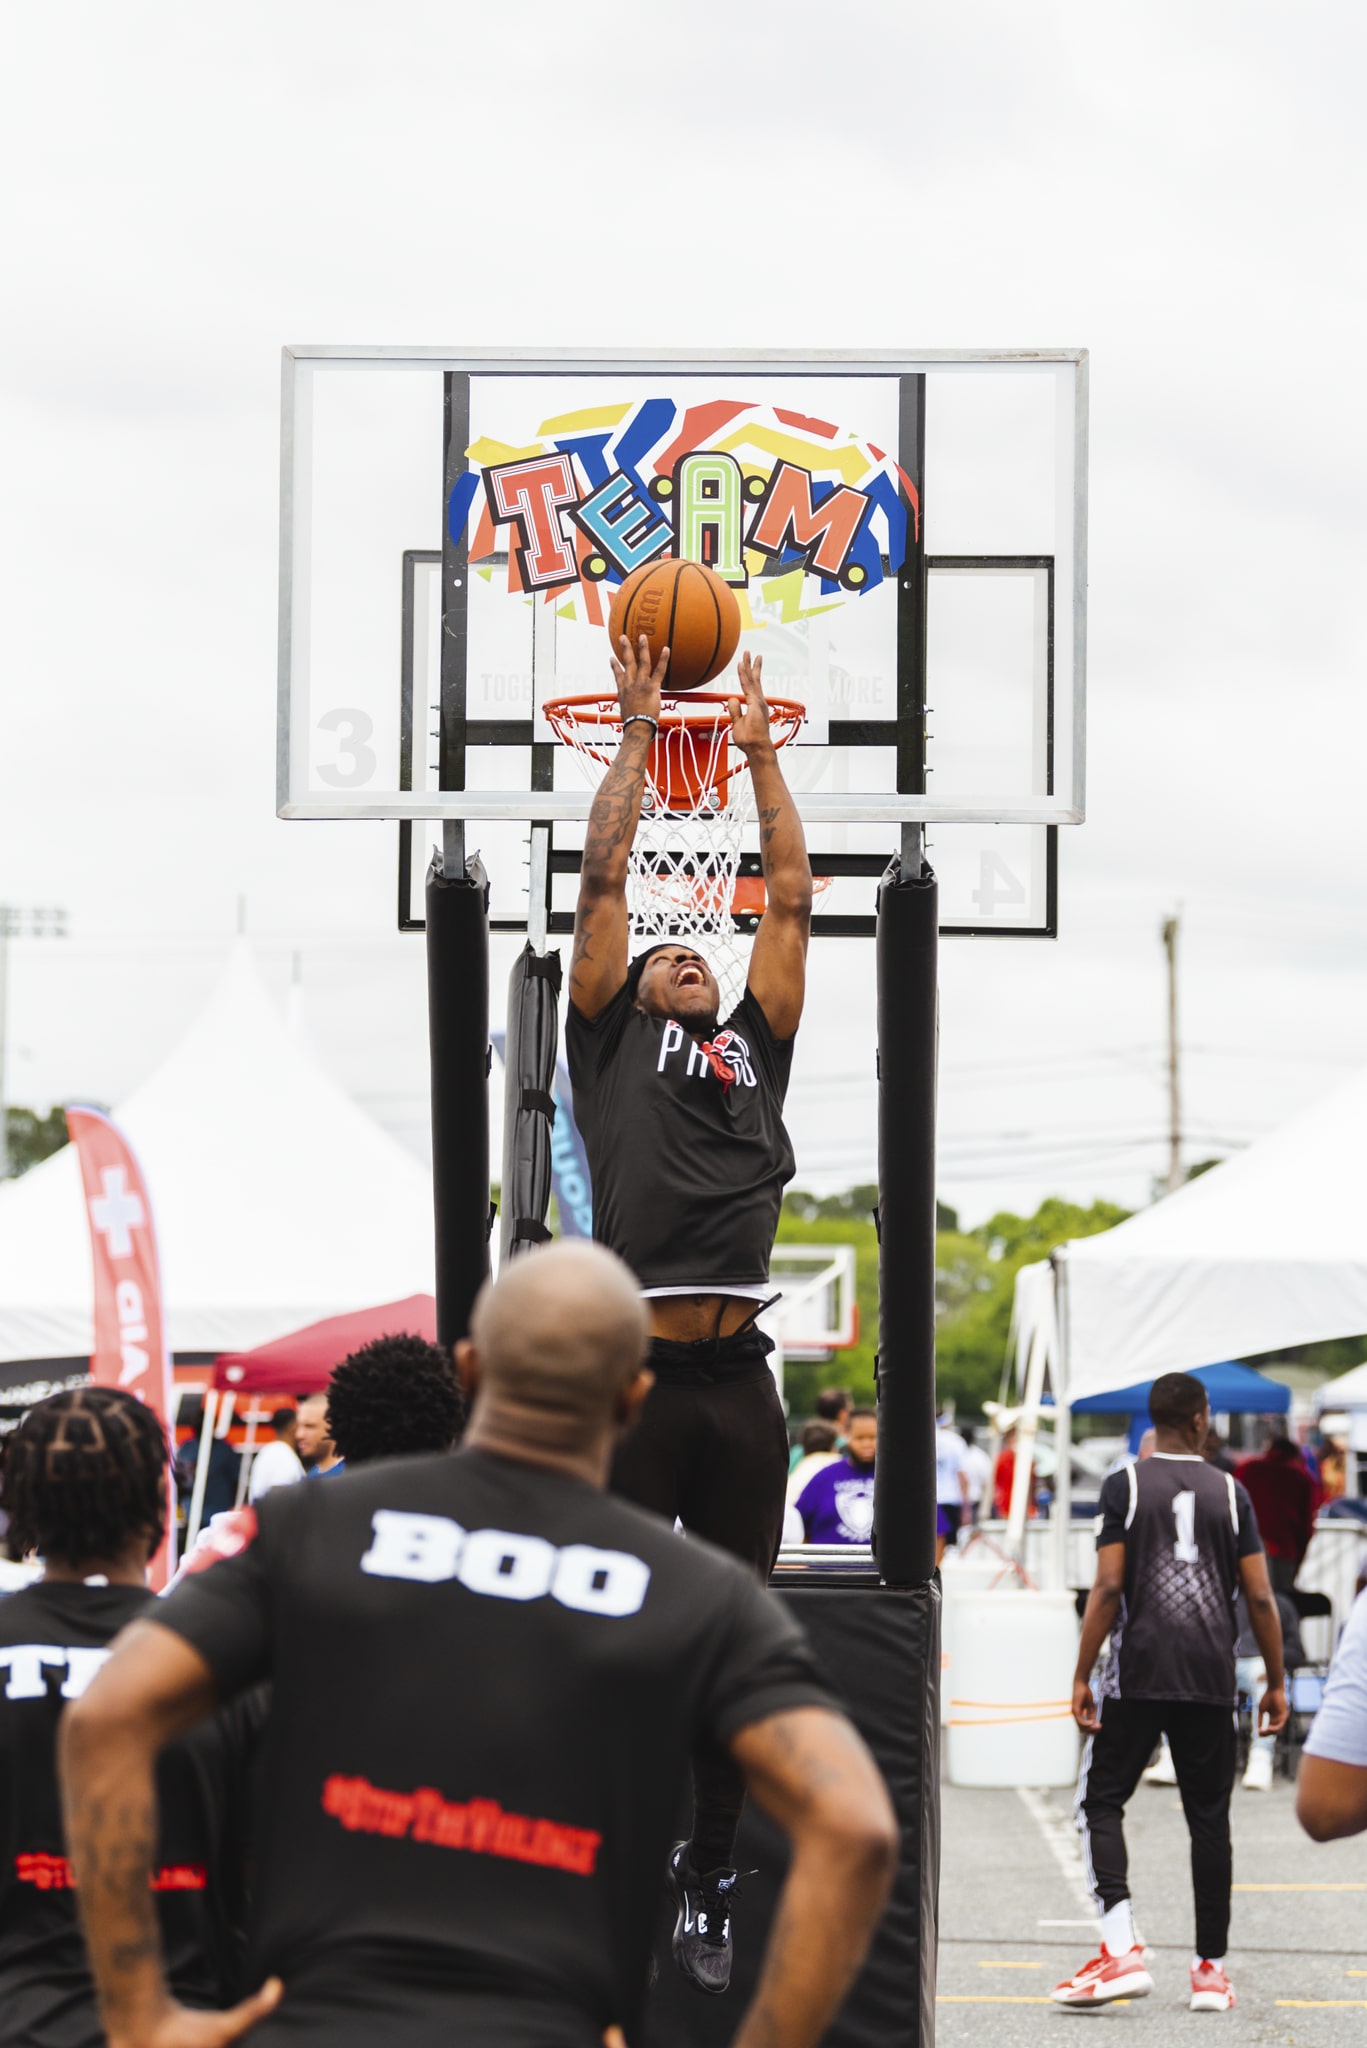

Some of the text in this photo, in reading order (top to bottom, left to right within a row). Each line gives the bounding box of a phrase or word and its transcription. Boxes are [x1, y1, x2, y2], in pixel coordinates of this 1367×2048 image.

[315, 708, 377, 788] 3
[361, 1508, 651, 1618] BOO
[1171, 1490, 1199, 1564] 1
